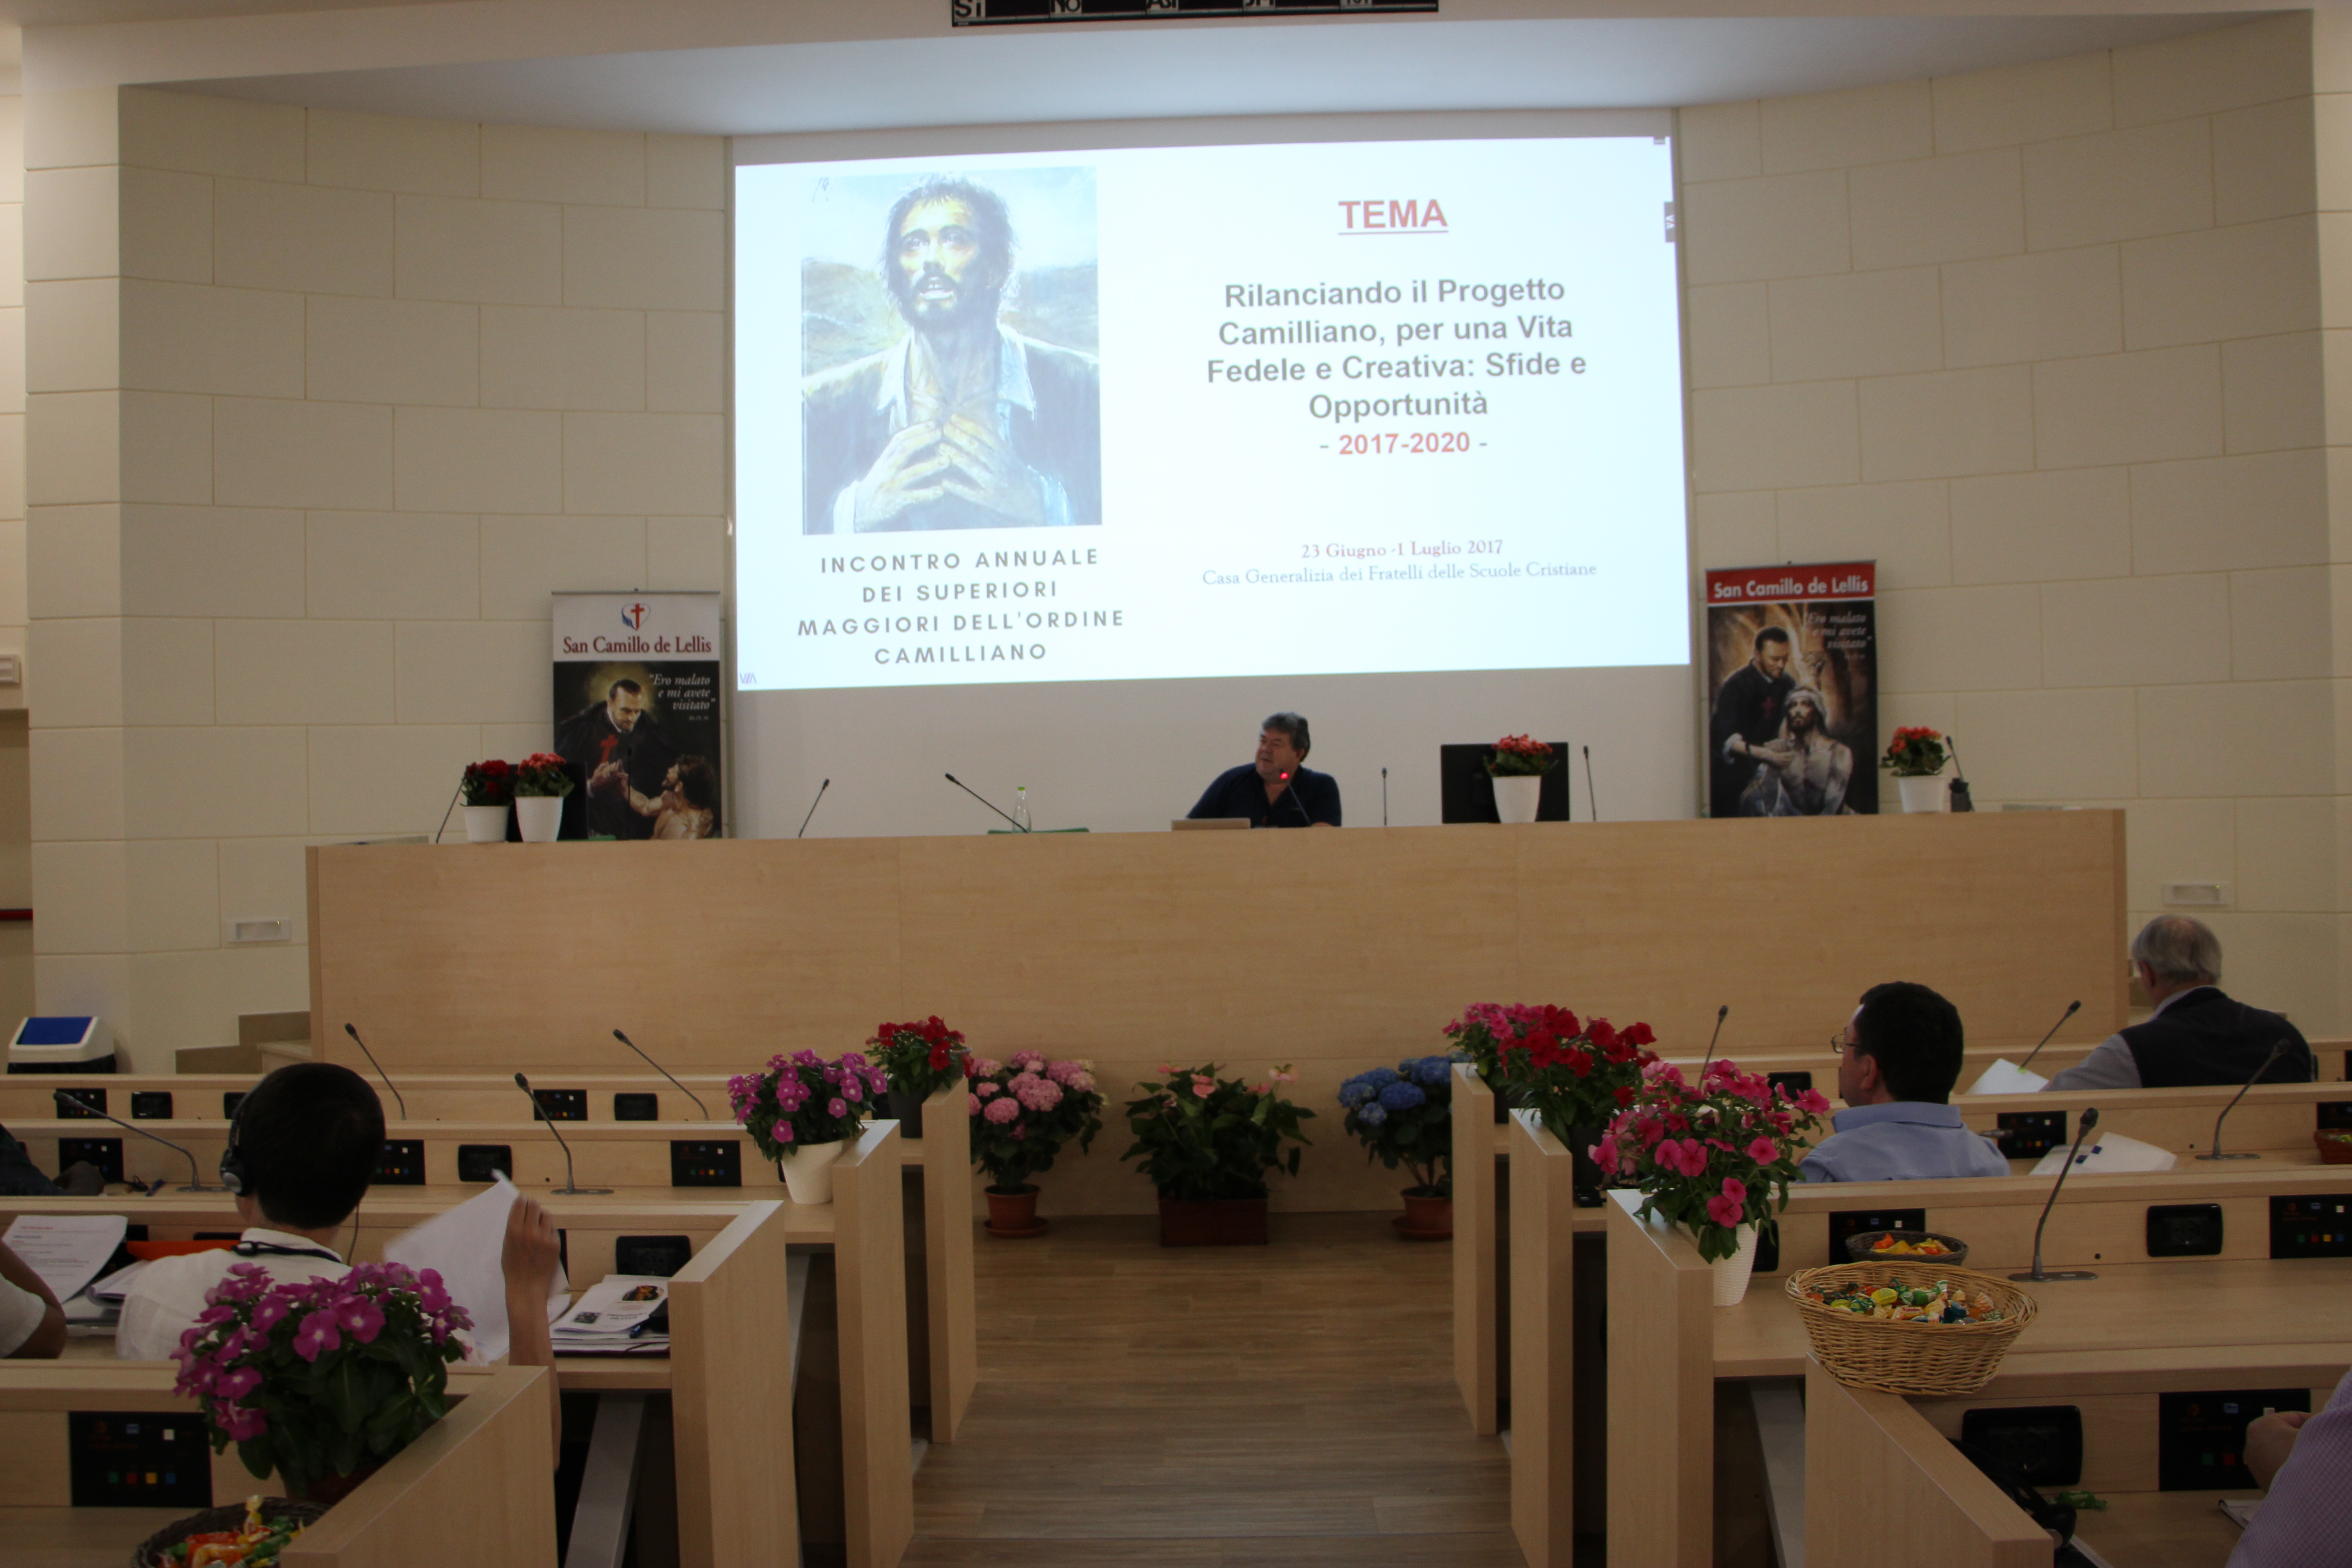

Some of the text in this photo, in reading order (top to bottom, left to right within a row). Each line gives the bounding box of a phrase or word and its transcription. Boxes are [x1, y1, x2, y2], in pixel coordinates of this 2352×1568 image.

[1338, 198, 1448, 229] TEMA
[1225, 277, 1566, 308] Rilanciando il Progetto
[1219, 314, 1573, 347] Camilliano, per una Vita
[1208, 351, 1587, 383] Fedele e Creativa: Sfide e
[1309, 391, 1489, 424] Opportunità
[1339, 431, 1470, 455] 2017-2020
[821, 548, 1097, 573] INCONTRO ANNUALE
[1301, 544, 1320, 559] 23
[1326, 542, 1387, 560] Giugno
[1410, 539, 1462, 557] Luglio
[1467, 539, 1504, 554] 2017
[1202, 561, 1597, 585] Casa Generalizia dei Fratelli delle Scuole Cristiane
[862, 580, 1056, 603] DEI SUPERIORI
[1714, 575, 1869, 599] San Camillo de Lellis
[797, 609, 1122, 636] MAGGIORI DELL'ORDINE
[563, 635, 711, 654] San Camillo de Lellis
[874, 643, 1046, 665] CAMILLIANO
[675, 673, 710, 686] malato
[658, 686, 710, 698] e mi avete
